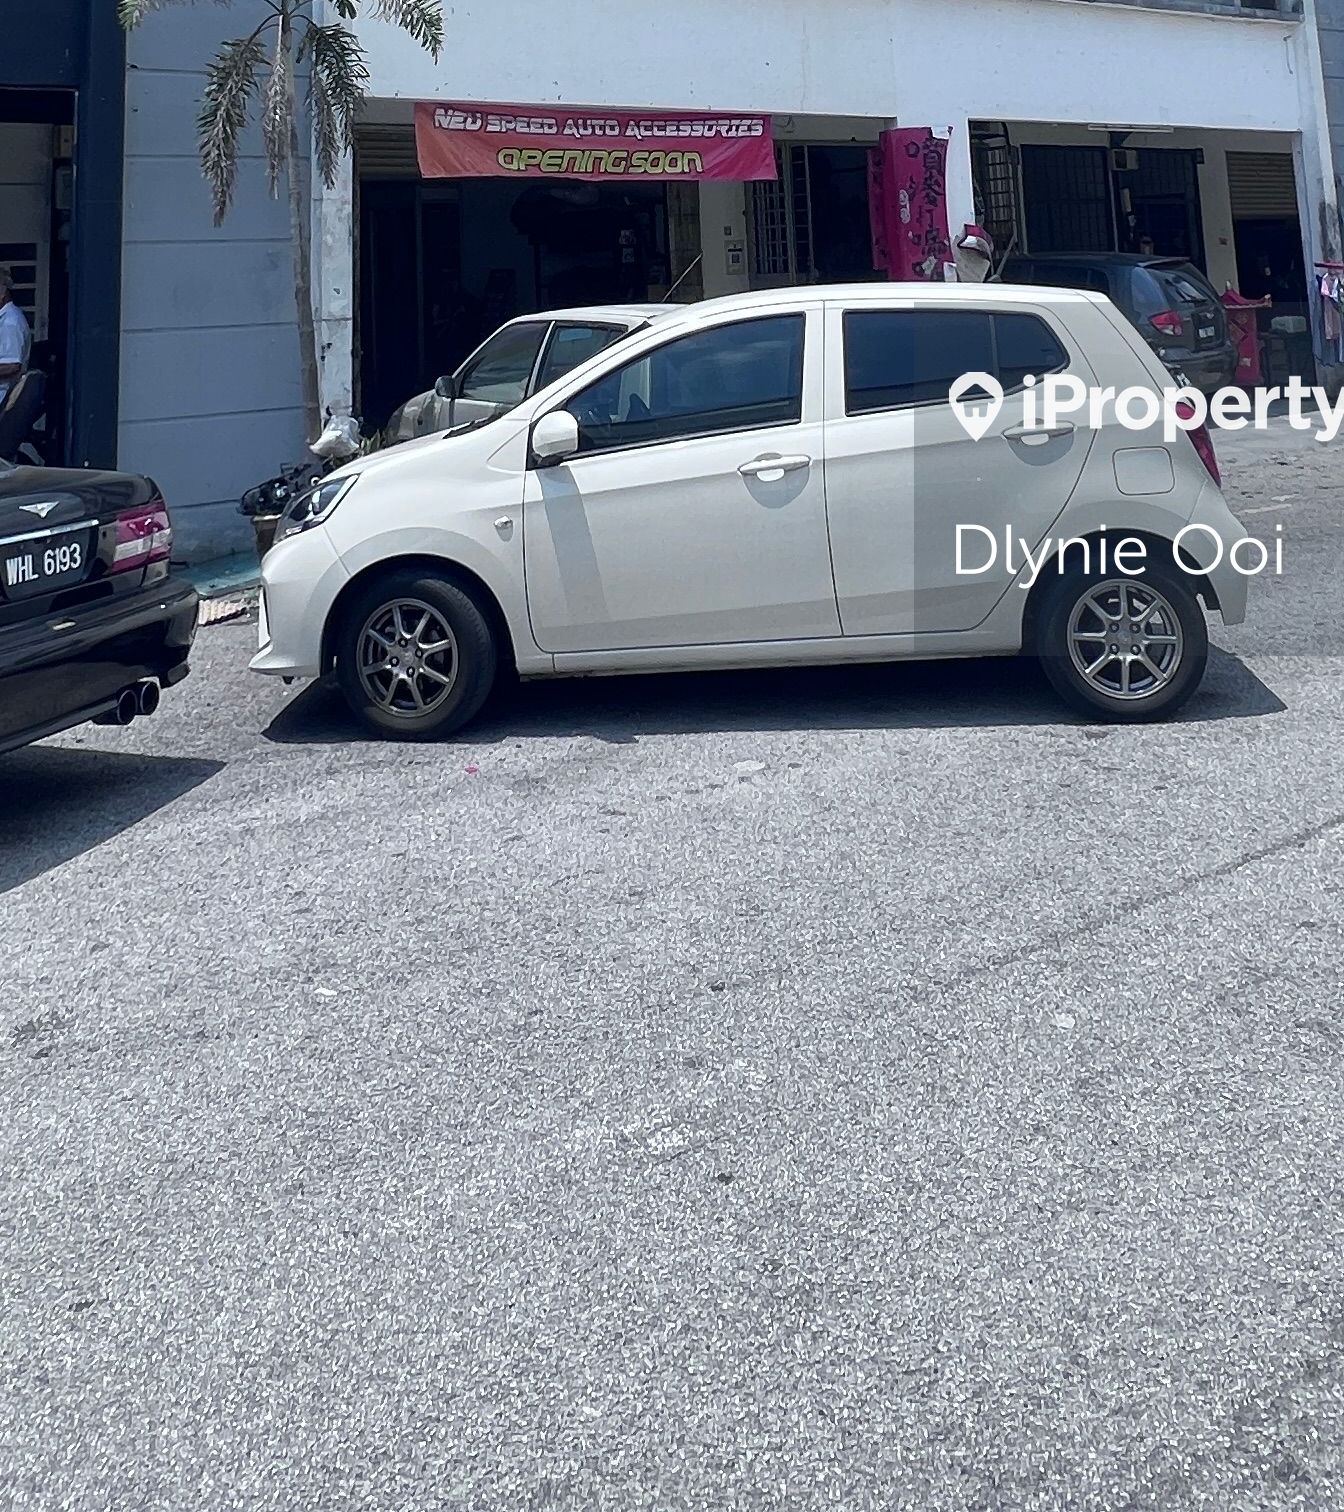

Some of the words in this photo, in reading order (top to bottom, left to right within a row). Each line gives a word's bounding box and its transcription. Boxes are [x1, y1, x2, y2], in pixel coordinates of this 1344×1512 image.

[486, 114, 558, 134] SPEED
[563, 118, 620, 138] AUTO
[624, 118, 764, 140] ACCESSORIES
[497, 147, 628, 174] OPENING
[628, 150, 703, 174] SOON
[6, 554, 39, 586] WHL
[43, 543, 82, 576] 6193
